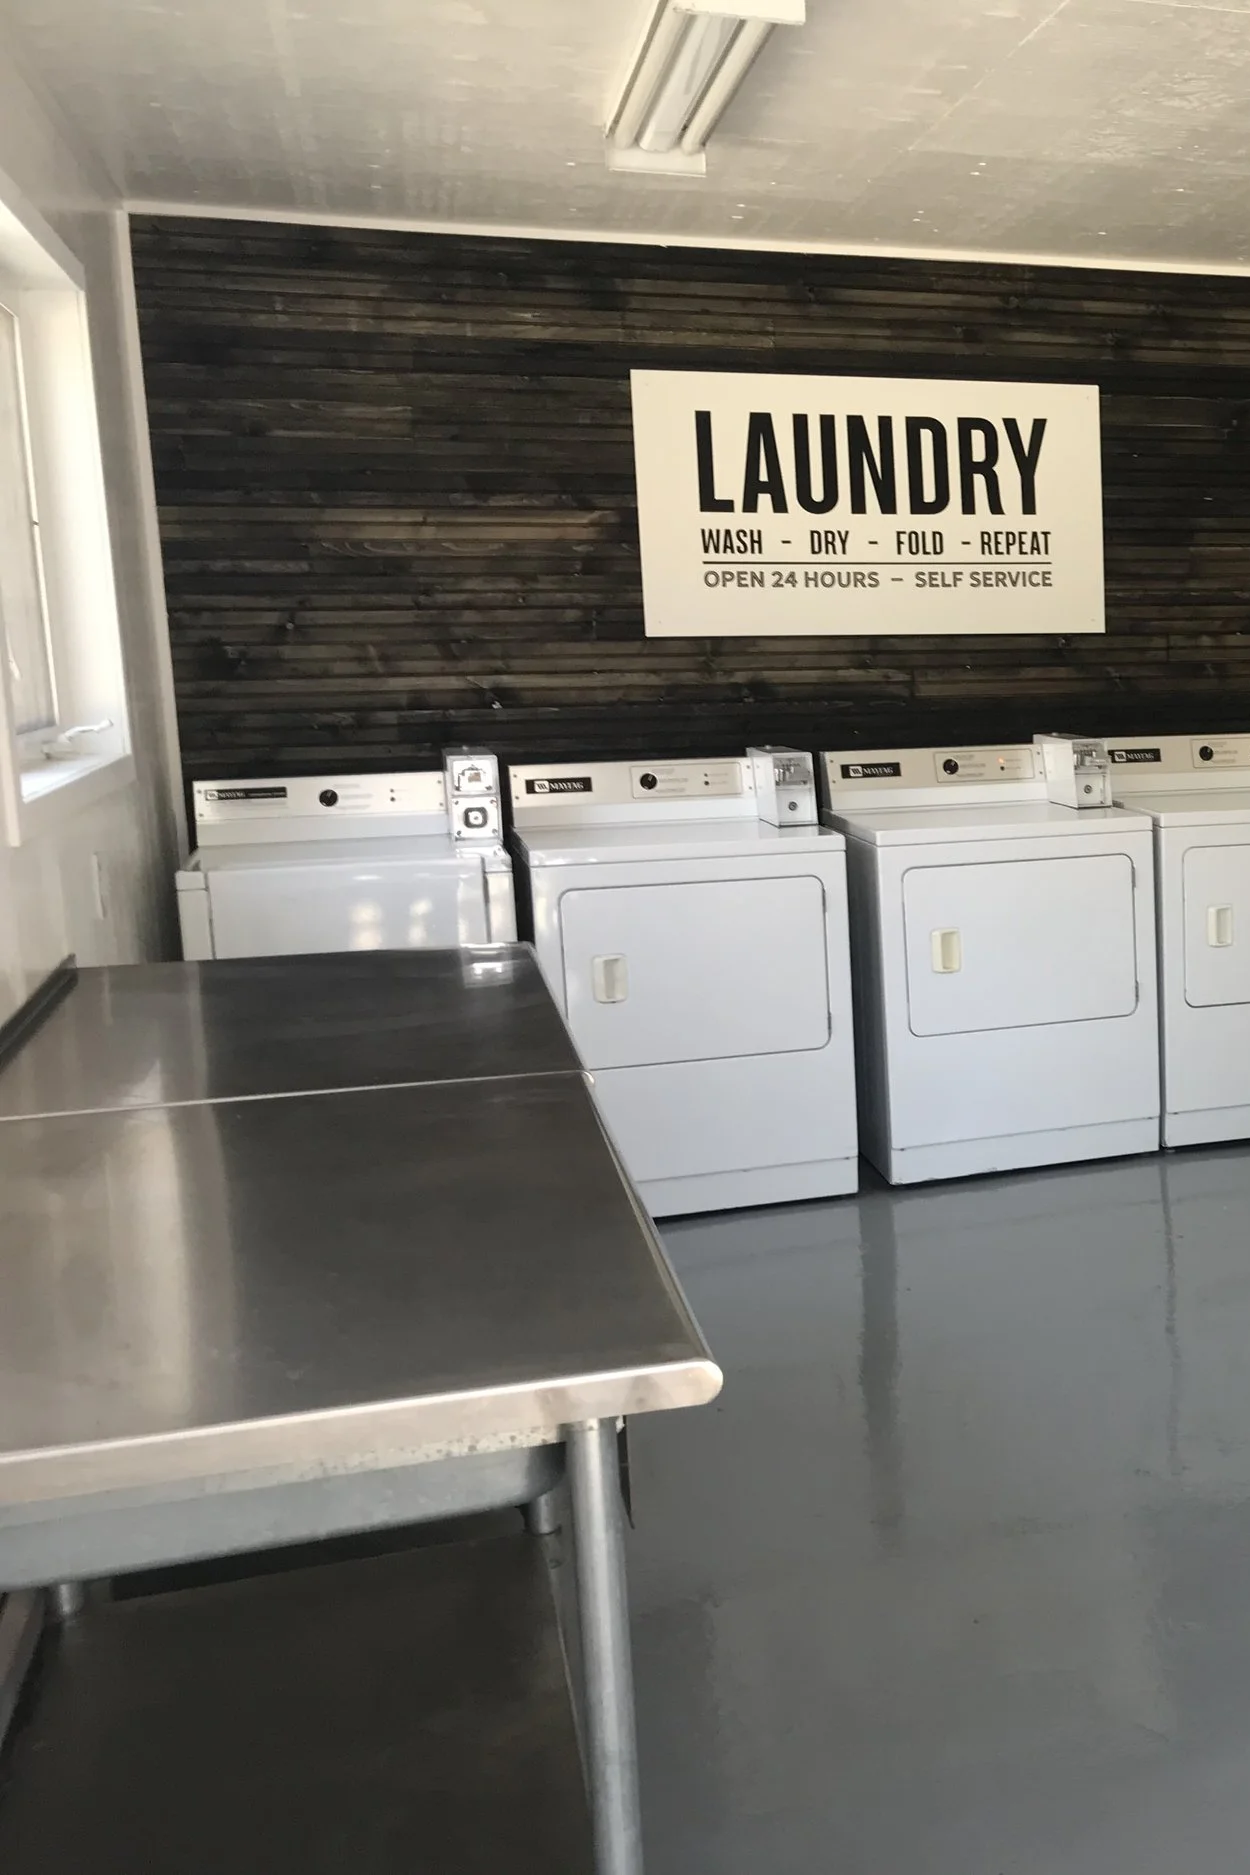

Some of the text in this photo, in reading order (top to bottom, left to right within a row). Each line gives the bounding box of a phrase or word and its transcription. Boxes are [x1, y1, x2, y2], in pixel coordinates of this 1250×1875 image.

[694, 410, 1048, 516] LAUNDRY
[700, 528, 763, 554] WASH
[810, 530, 850, 555] DRY
[896, 530, 944, 556] FOLD
[980, 530, 1052, 556] REPEAT
[704, 570, 765, 588] OPEN
[771, 570, 798, 588] 24
[804, 571, 880, 588] HOURS
[915, 571, 964, 588] SELF
[969, 571, 1053, 588] SERVICE
[1126, 751, 1155, 761] MAYTAG
[862, 766, 894, 776] MAYTAG
[550, 781, 584, 791] MAYTAG
